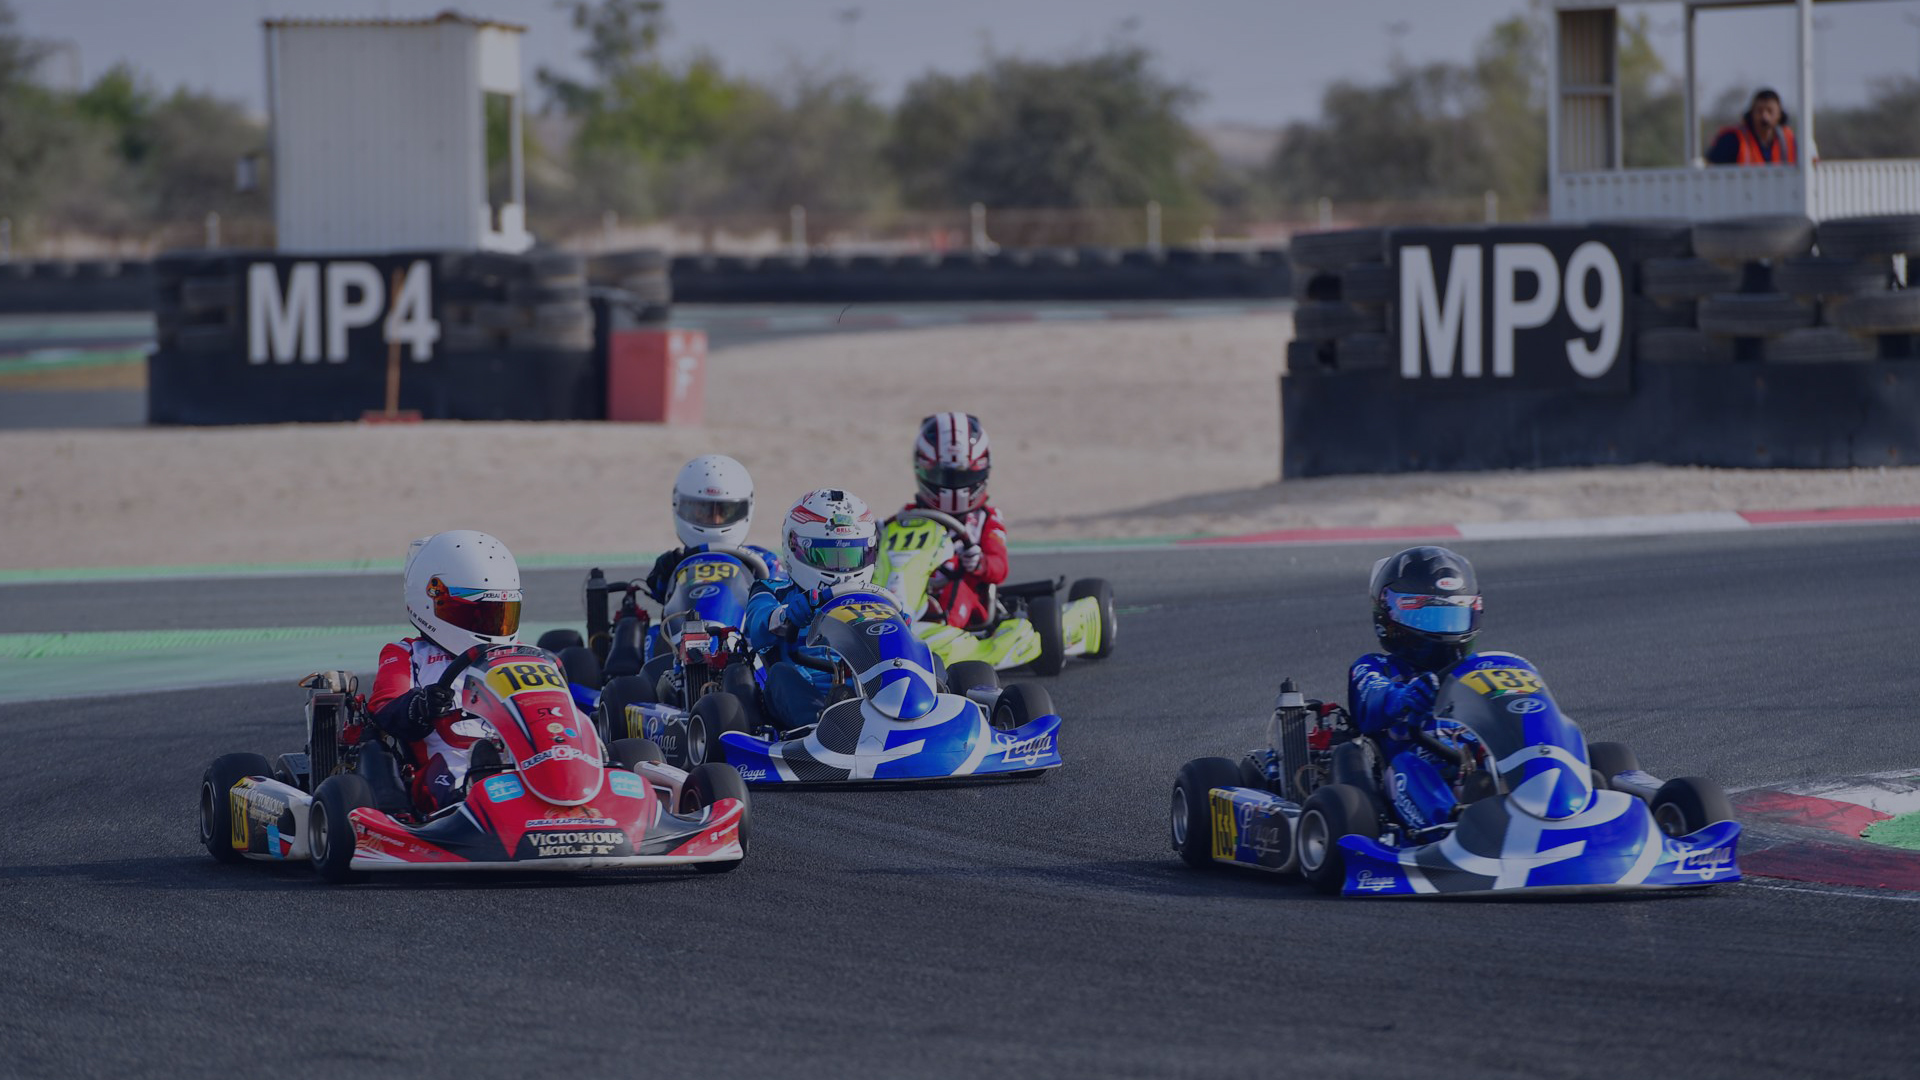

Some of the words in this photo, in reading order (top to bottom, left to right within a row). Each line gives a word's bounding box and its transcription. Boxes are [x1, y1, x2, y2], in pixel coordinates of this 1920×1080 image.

[248, 259, 441, 364] MP4
[1400, 240, 1624, 378] MP9
[888, 531, 929, 550] 111
[497, 664, 565, 691] 188
[995, 732, 1053, 766] Praga
[736, 764, 767, 781] Praga
[527, 832, 624, 847] VICTORIOUS
